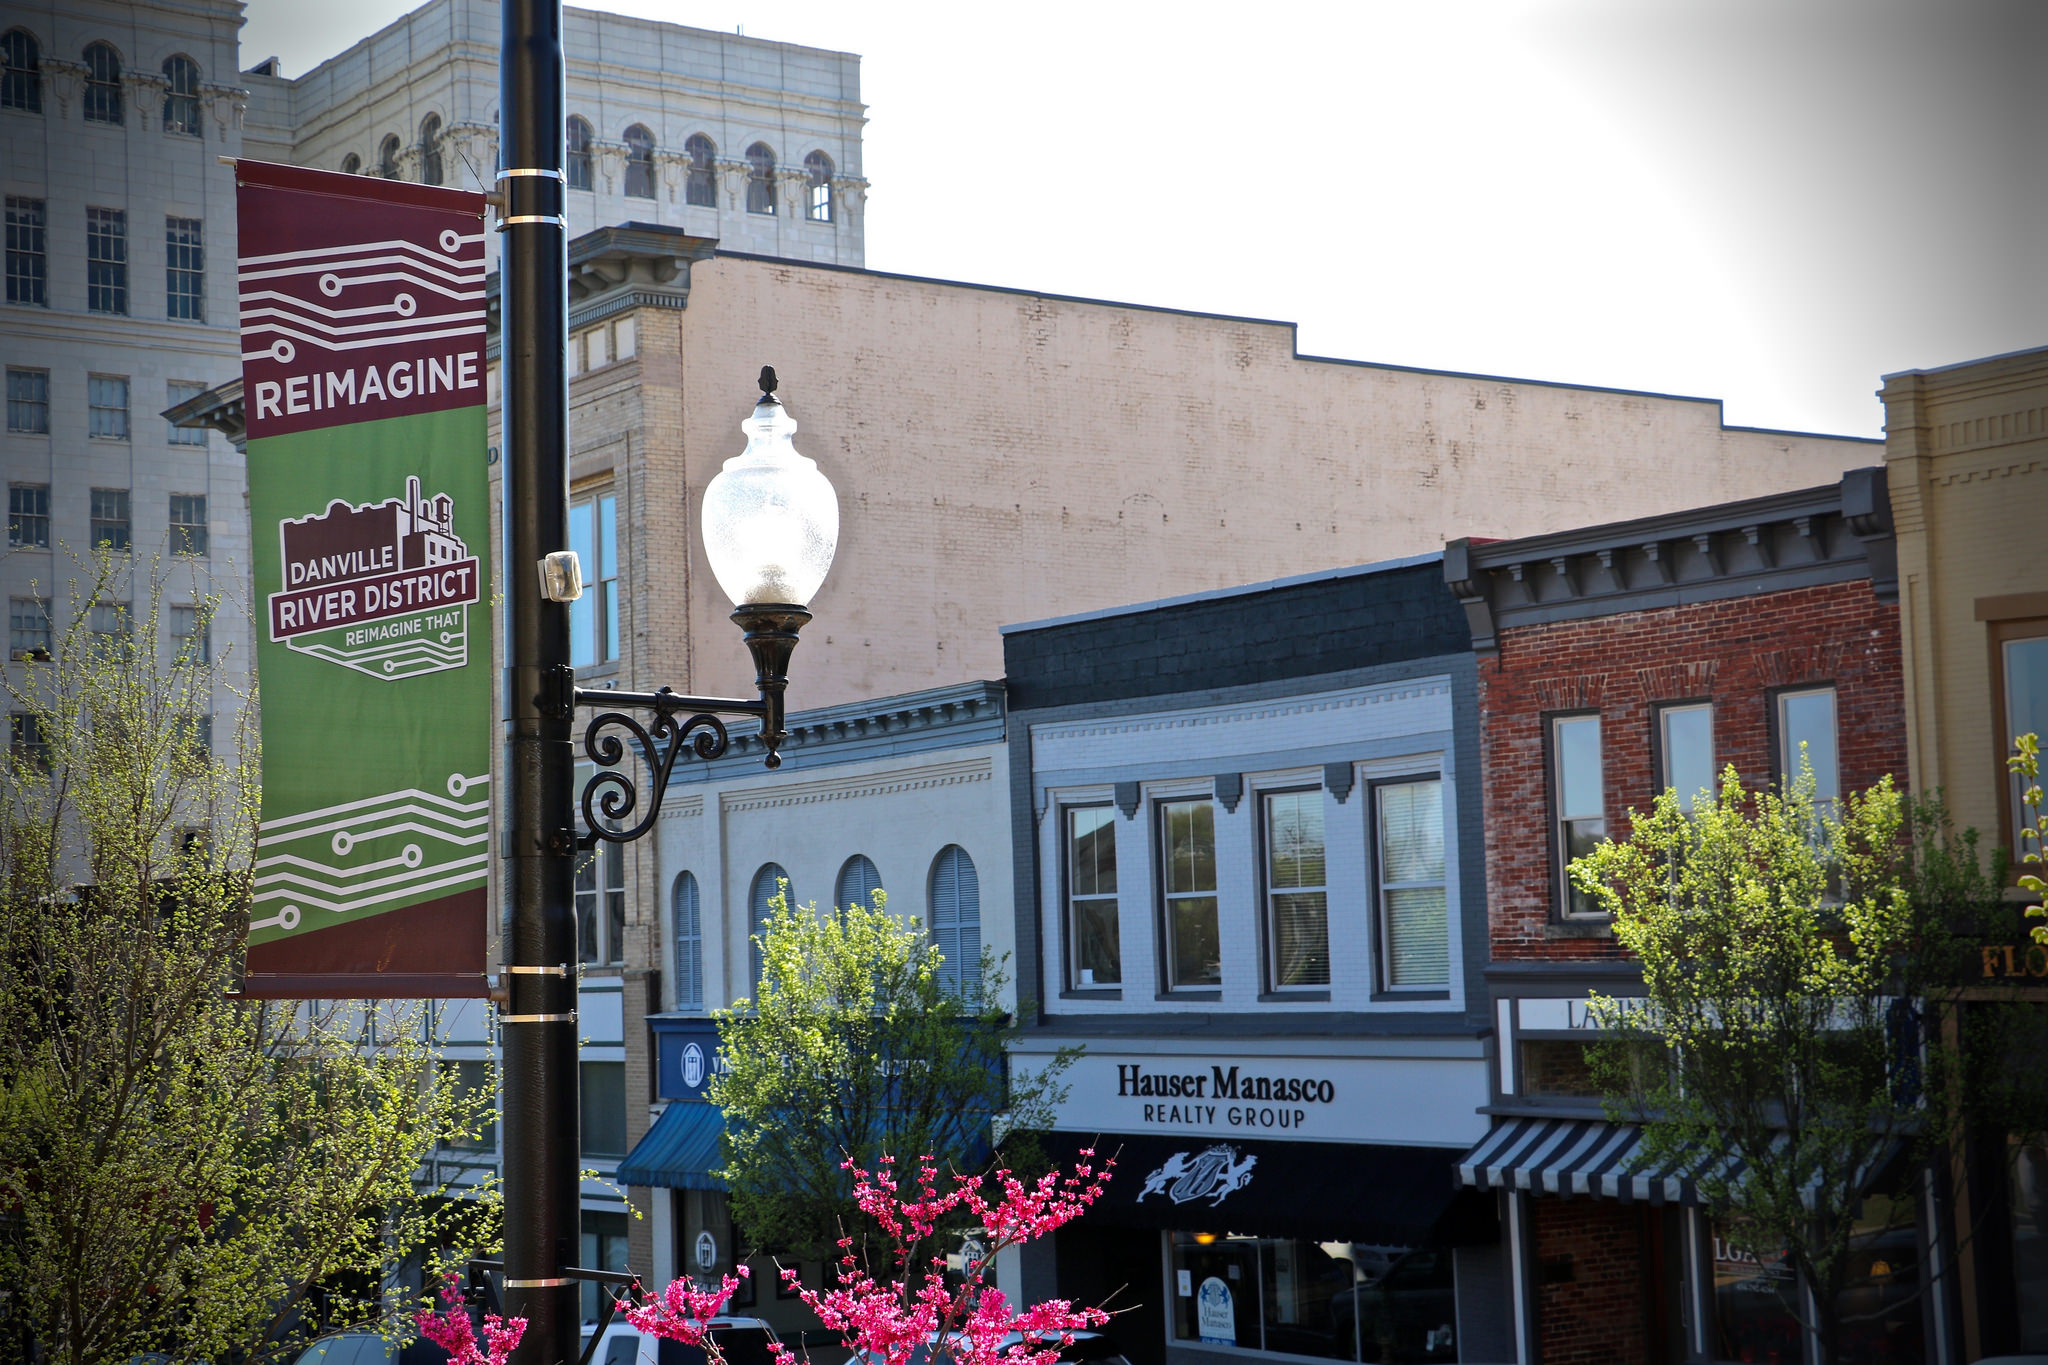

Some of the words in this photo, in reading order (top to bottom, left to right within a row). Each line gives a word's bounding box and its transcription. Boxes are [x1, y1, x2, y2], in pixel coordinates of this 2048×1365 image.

[255, 351, 479, 420] REIMAGINE
[290, 545, 394, 585] DANVILLE
[280, 589, 357, 630] RIVER
[365, 568, 471, 614] DISTRICT
[346, 619, 422, 646] REIMAGINE
[425, 611, 461, 630] THAT
[1117, 1064, 1207, 1098] Hauser
[1211, 1066, 1335, 1103] Manasco
[1144, 1104, 1216, 1124] REALTY
[1227, 1107, 1305, 1128] GROUP
